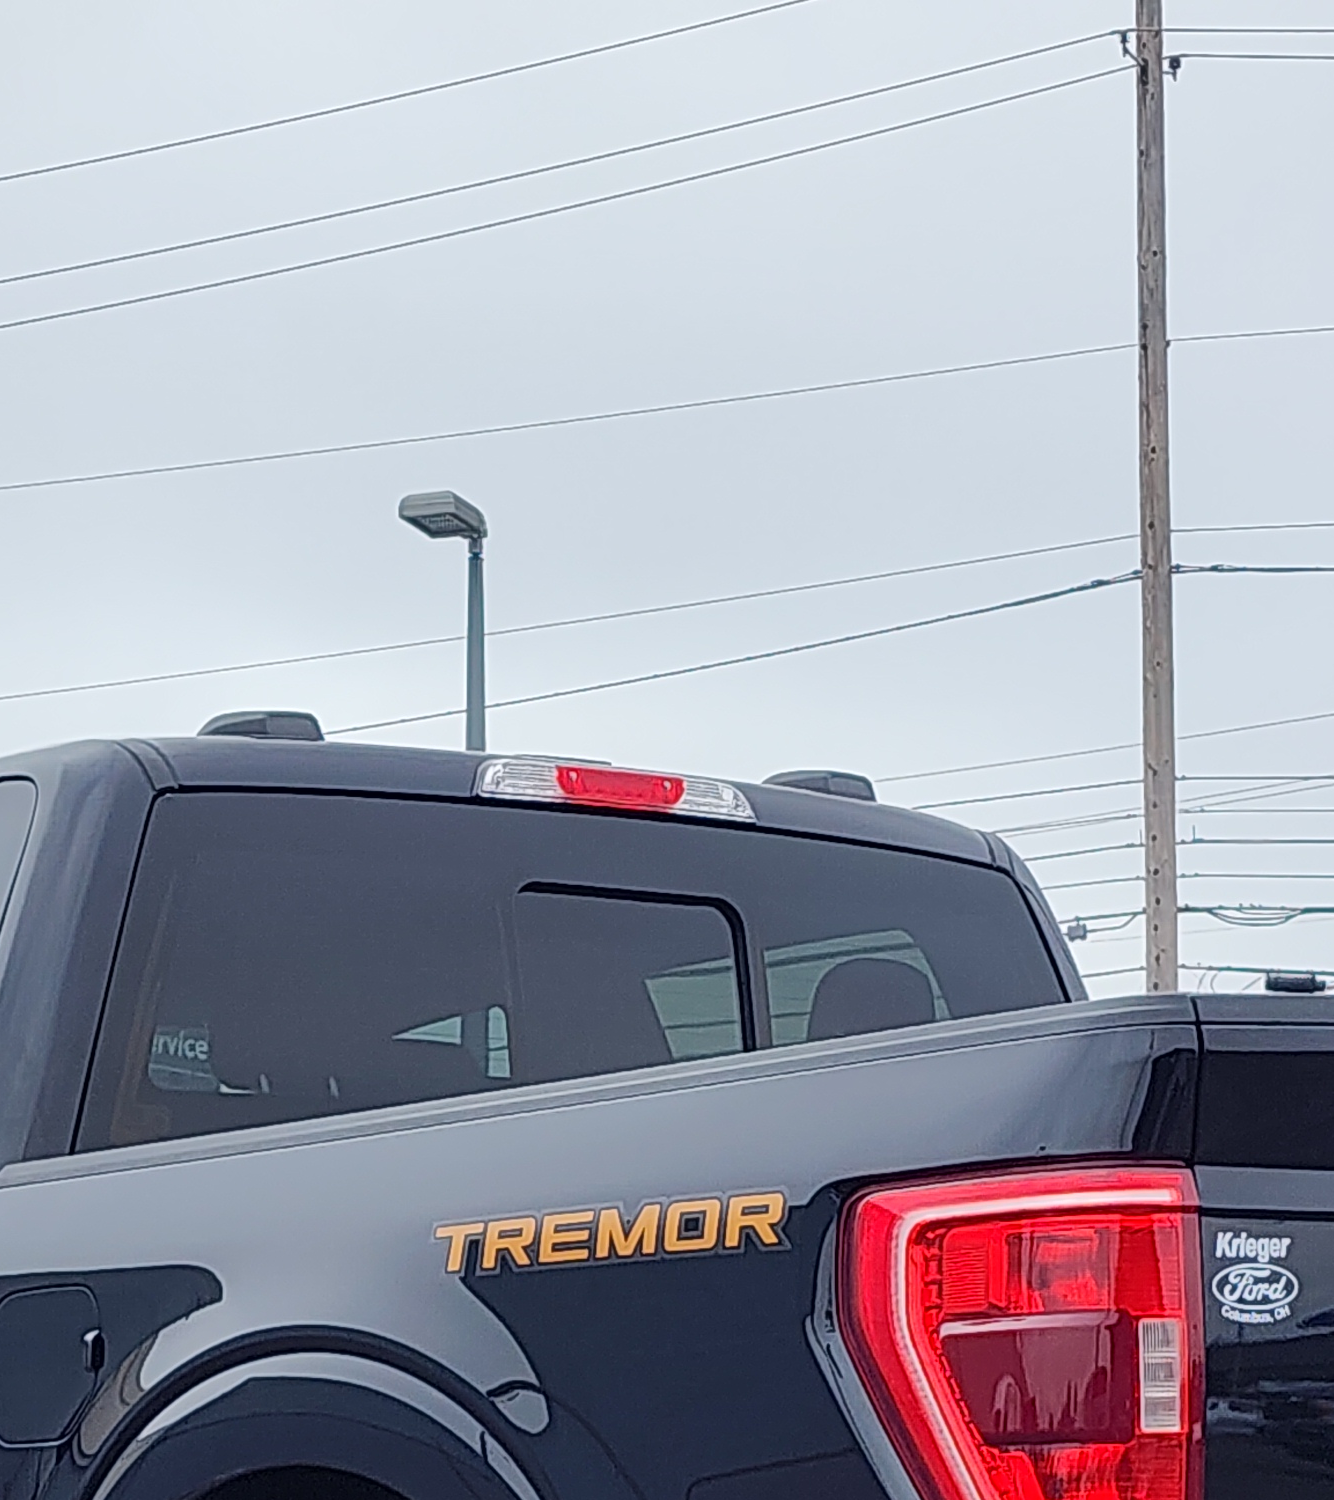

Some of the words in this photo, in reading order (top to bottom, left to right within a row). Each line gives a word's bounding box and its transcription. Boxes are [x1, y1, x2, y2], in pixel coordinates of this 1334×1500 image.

[152, 1029, 209, 1060] rvice
[434, 1190, 785, 1274] TREMOR
[1215, 1231, 1292, 1263] Krieger
[1223, 1268, 1287, 1302] Ford
[1274, 1304, 1291, 1320] OH
